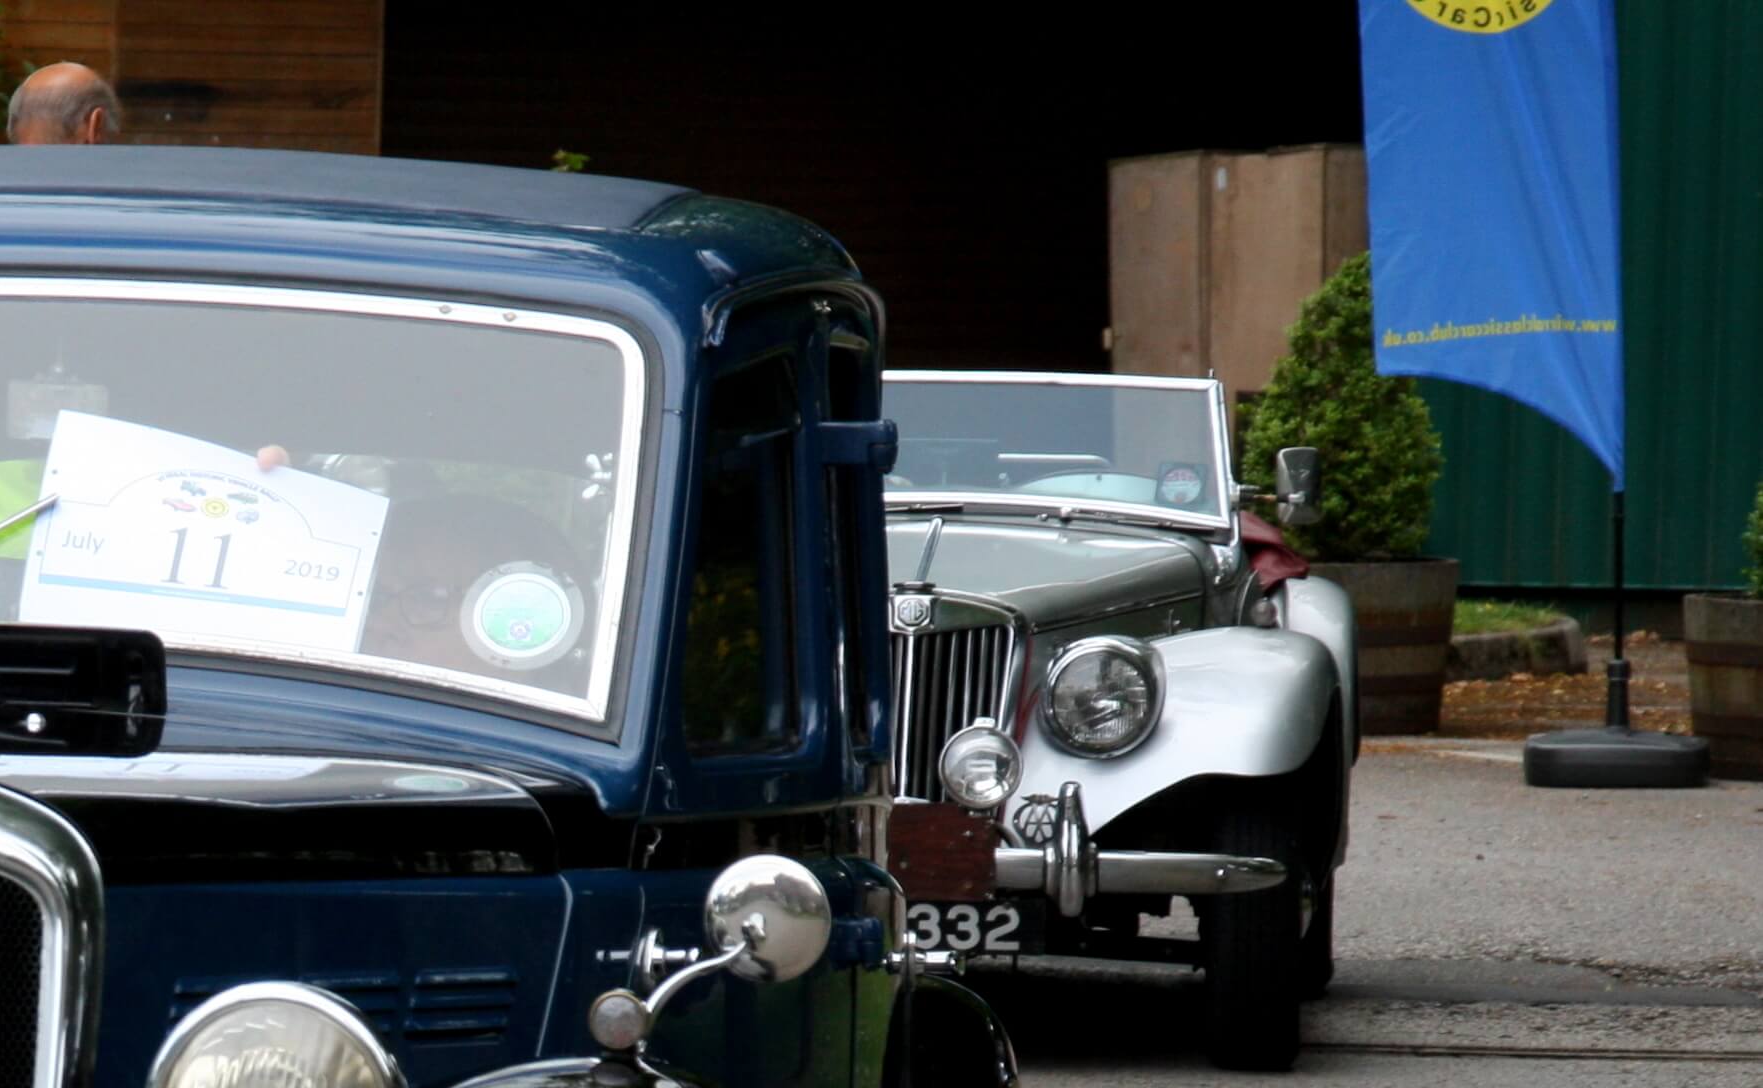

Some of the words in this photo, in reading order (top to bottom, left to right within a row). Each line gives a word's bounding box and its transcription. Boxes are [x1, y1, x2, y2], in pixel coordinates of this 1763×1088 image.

[61, 530, 105, 554] July
[161, 526, 233, 590] 11
[283, 559, 340, 582] 2019
[907, 903, 1021, 951] 332
